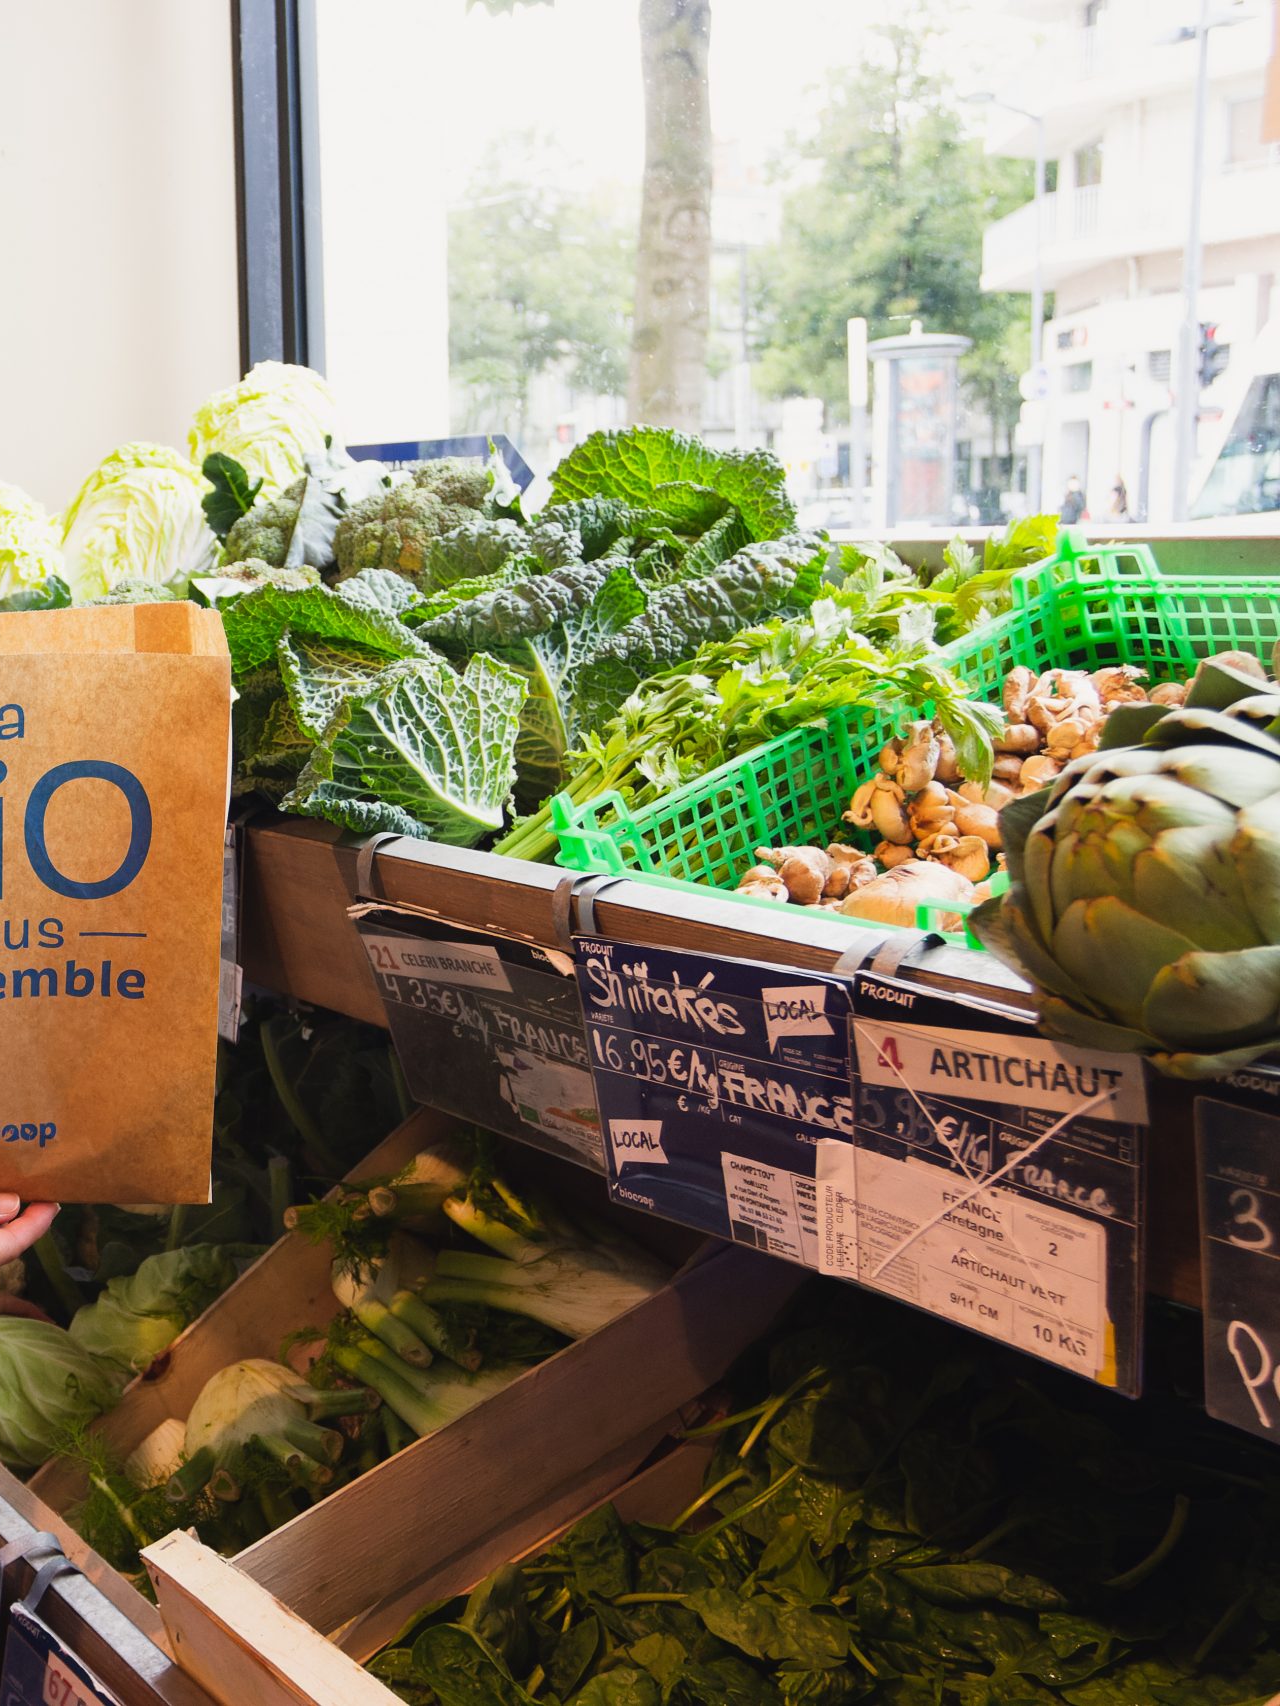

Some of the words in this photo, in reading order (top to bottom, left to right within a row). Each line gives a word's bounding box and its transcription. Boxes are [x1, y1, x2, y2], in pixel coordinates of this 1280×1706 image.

[370, 944, 401, 970] 21
[401, 953, 438, 969] CELERI
[438, 957, 497, 976] BRANCHE
[579, 941, 614, 957] PRODUIT
[860, 981, 917, 1008] PRODUIT
[766, 999, 826, 1023] LOCAL
[876, 1036, 904, 1077] 4
[930, 1048, 1123, 1101] ARTICHAUT
[718, 1070, 854, 1135] FRANCE
[728, 1114, 743, 1126] CAT
[613, 1130, 660, 1152] LOCAL
[999, 1131, 1032, 1149] ORIGIN
[825, 1185, 834, 1242] PRODUCTEUR
[942, 1190, 1003, 1225] FRANCE
[1229, 1189, 1274, 1249] 3
[942, 1210, 1005, 1243] Bretagne
[825, 1243, 834, 1267] CODE
[835, 1231, 845, 1268] LEJEUNE
[1048, 1242, 1059, 1257] 2
[950, 1254, 1027, 1291] ARTICHAUT
[1028, 1282, 1067, 1306] VERT
[949, 1291, 975, 1311] 9/11
[978, 1302, 1000, 1320] CM
[1032, 1322, 1054, 1344] 10
[1058, 1333, 1088, 1357] KG
